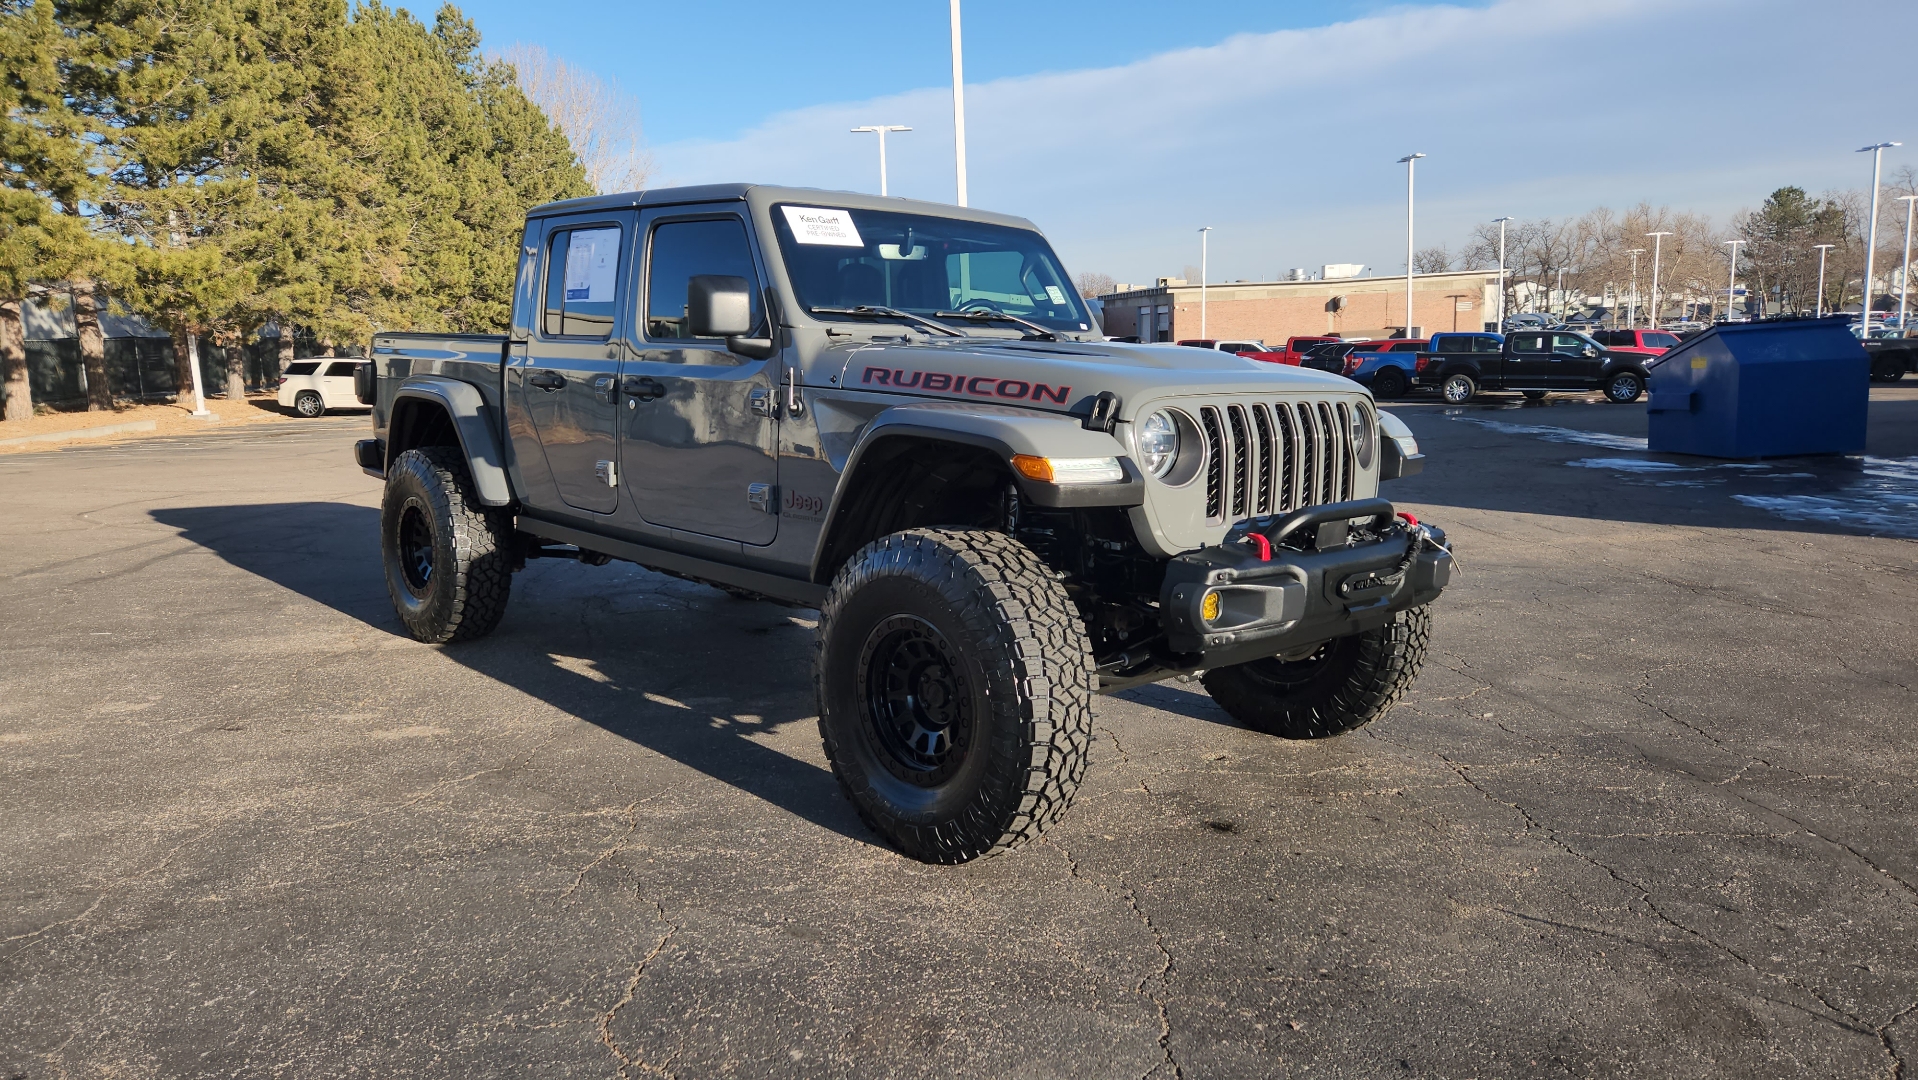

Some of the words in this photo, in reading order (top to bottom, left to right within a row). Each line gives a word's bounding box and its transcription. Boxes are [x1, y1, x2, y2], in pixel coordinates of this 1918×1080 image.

[799, 214, 818, 223] Ken
[861, 366, 1073, 406] RUBICON
[785, 489, 823, 515] Jeep
